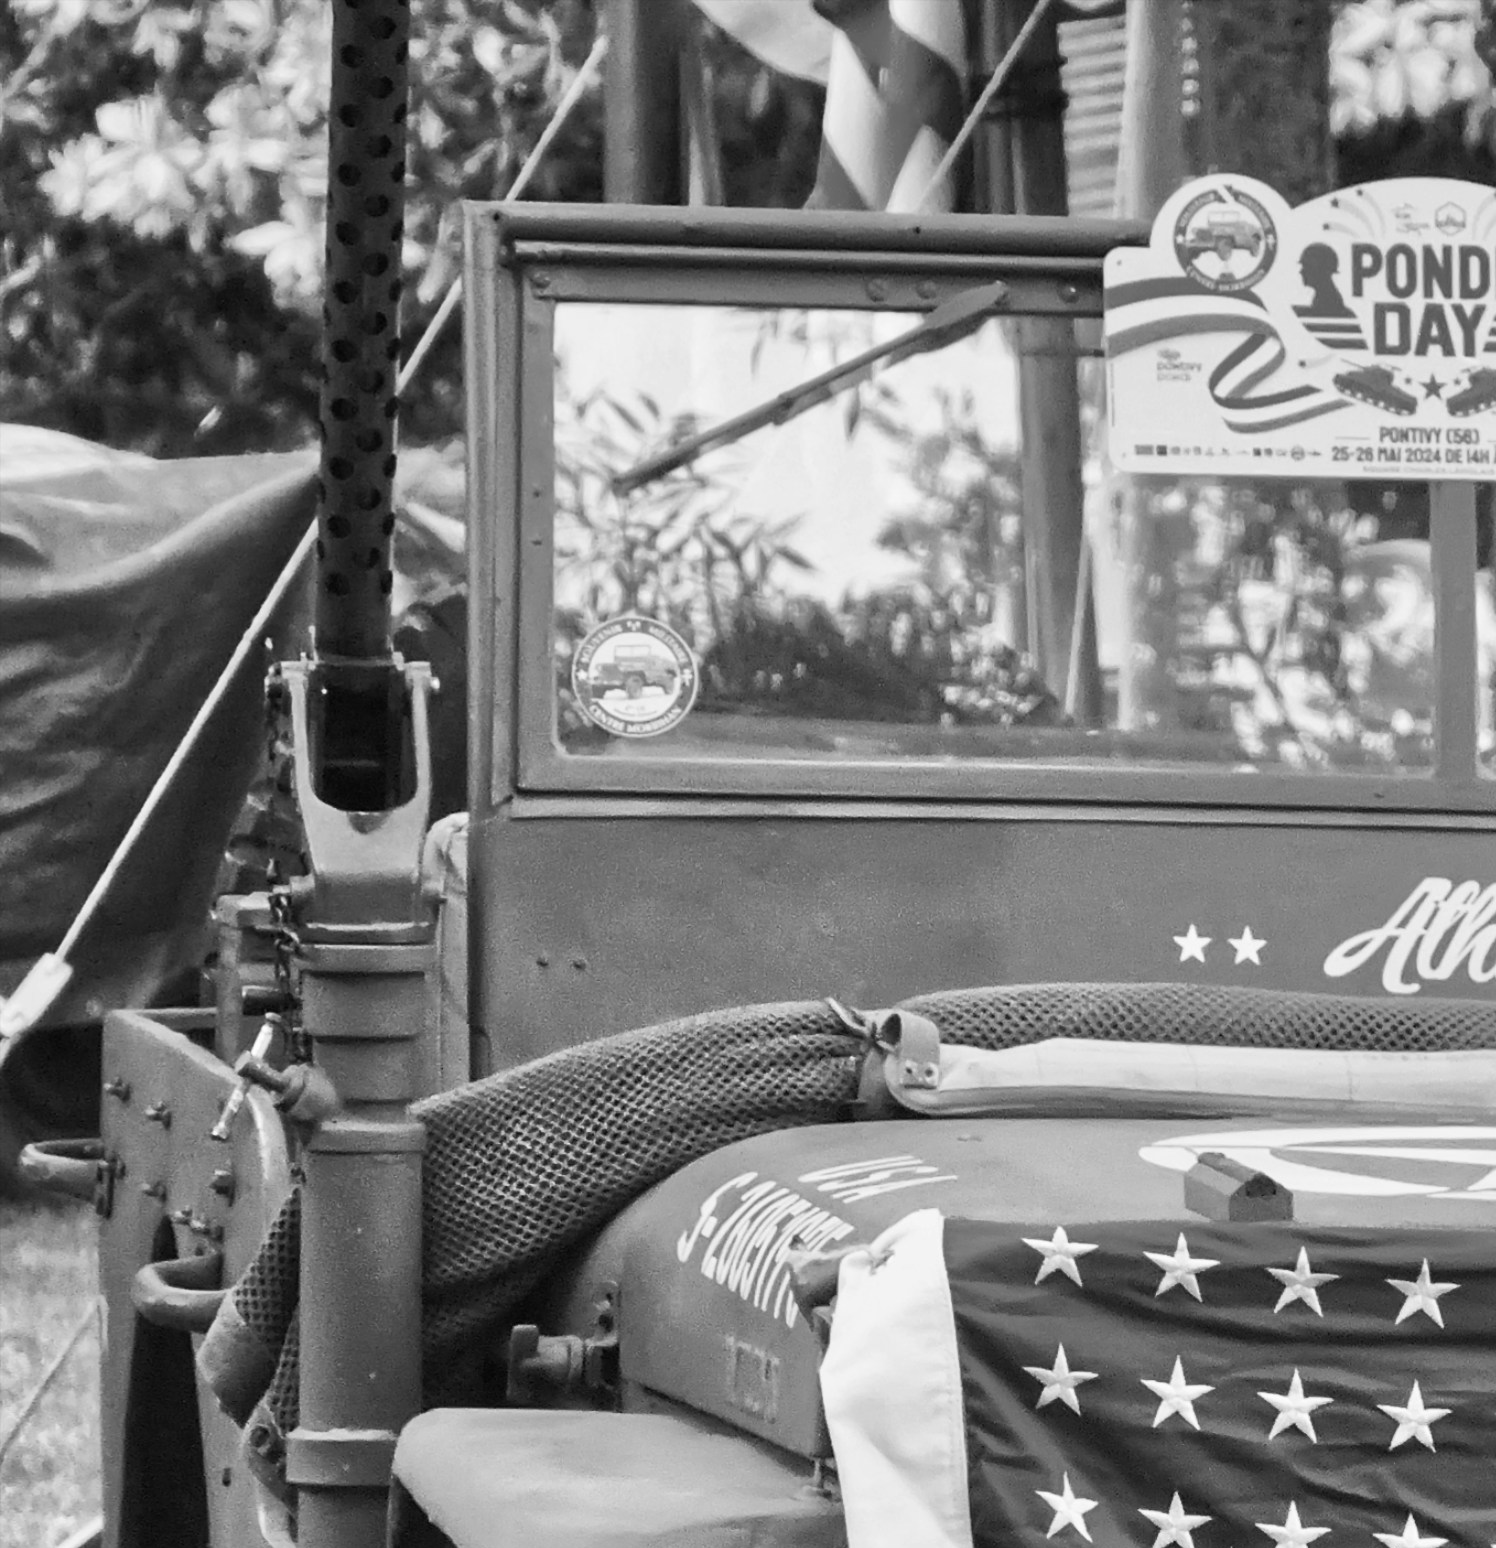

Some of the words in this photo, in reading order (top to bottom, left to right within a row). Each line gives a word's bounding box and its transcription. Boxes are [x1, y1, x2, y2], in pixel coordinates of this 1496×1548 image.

[1374, 303, 1487, 357] DAY
[1379, 427, 1441, 444] PONTIVY
[1332, 446, 1374, 462] 25-26
[1378, 447, 1401, 463] MAI
[1405, 448, 1441, 463] 2024
[1446, 449, 1463, 464] DE
[1467, 450, 1490, 465] 14H
[580, 624, 622, 663] SOUVENIR
[589, 705, 626, 732] CENTRE
[627, 706, 682, 733] MORBIHAN
